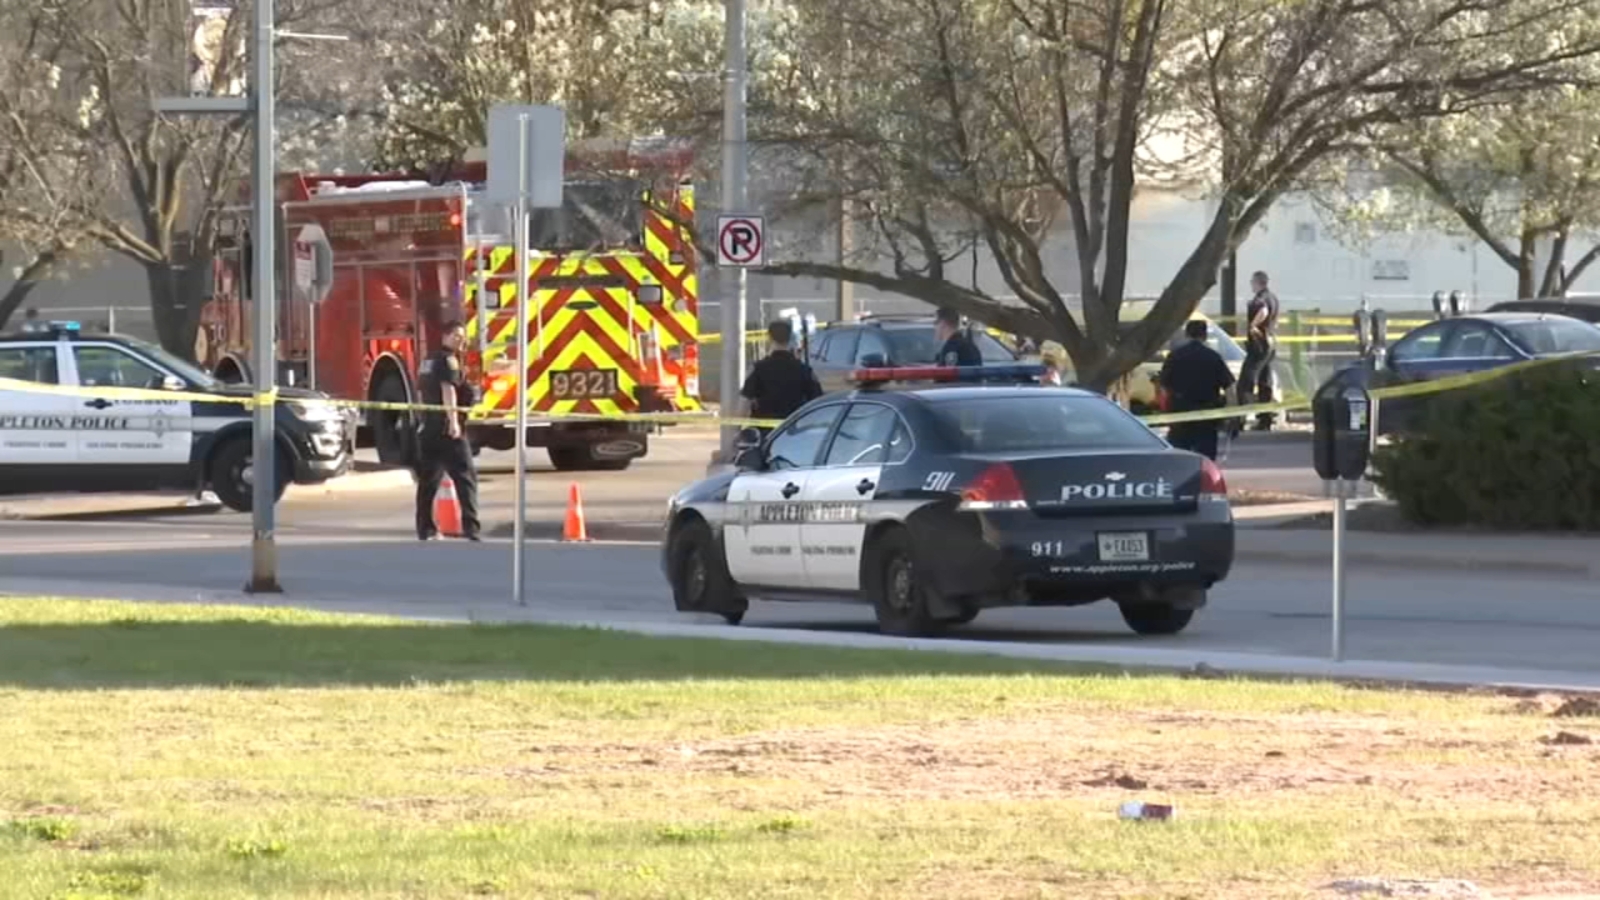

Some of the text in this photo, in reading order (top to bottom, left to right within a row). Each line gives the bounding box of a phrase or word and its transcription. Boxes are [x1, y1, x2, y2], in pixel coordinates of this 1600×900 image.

[553, 371, 617, 396] 9321
[70, 415, 130, 430] POLICE
[921, 471, 956, 491] 911
[1061, 481, 1174, 500] POLICE
[1031, 541, 1062, 557] 911
